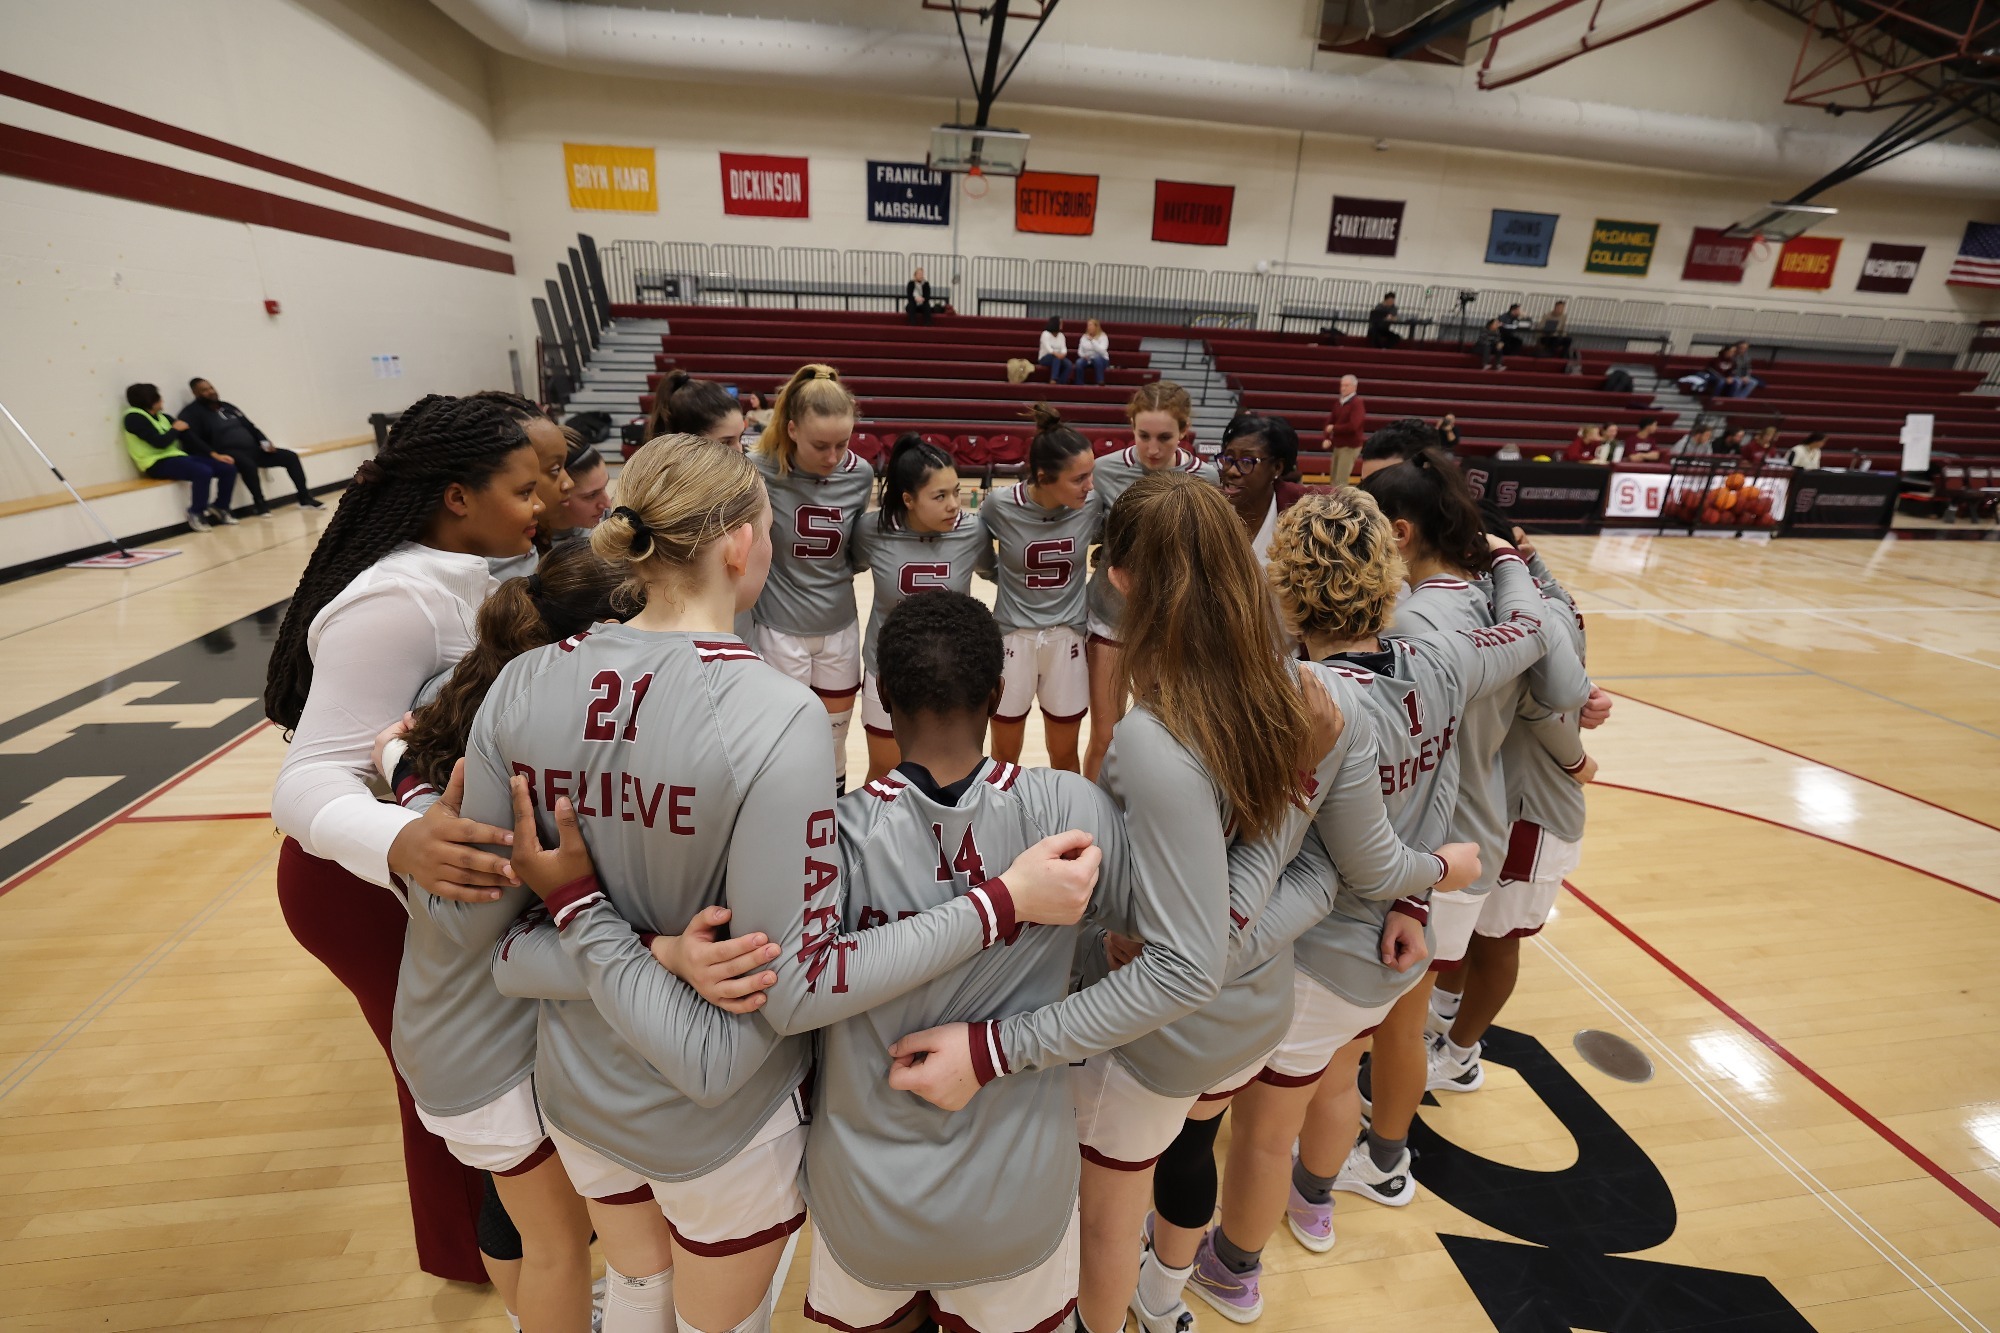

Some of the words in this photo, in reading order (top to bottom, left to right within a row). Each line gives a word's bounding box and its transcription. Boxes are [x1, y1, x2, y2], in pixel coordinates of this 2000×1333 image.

[572, 163, 609, 190] BRYN
[612, 166, 649, 192] MAWR
[729, 168, 802, 203] DICKINSON
[876, 166, 942, 186] FRANKLIN
[906, 187, 914, 199] &
[1020, 187, 1093, 218] GETTYSBURG
[874, 201, 942, 221] MARSHALL
[1333, 213, 1398, 241] SWARTHMORE
[1590, 248, 1649, 268] COLLEGE
[792, 503, 844, 560] S
[1024, 536, 1076, 591] S
[582, 668, 655, 745] 21
[931, 820, 988, 888] 14
